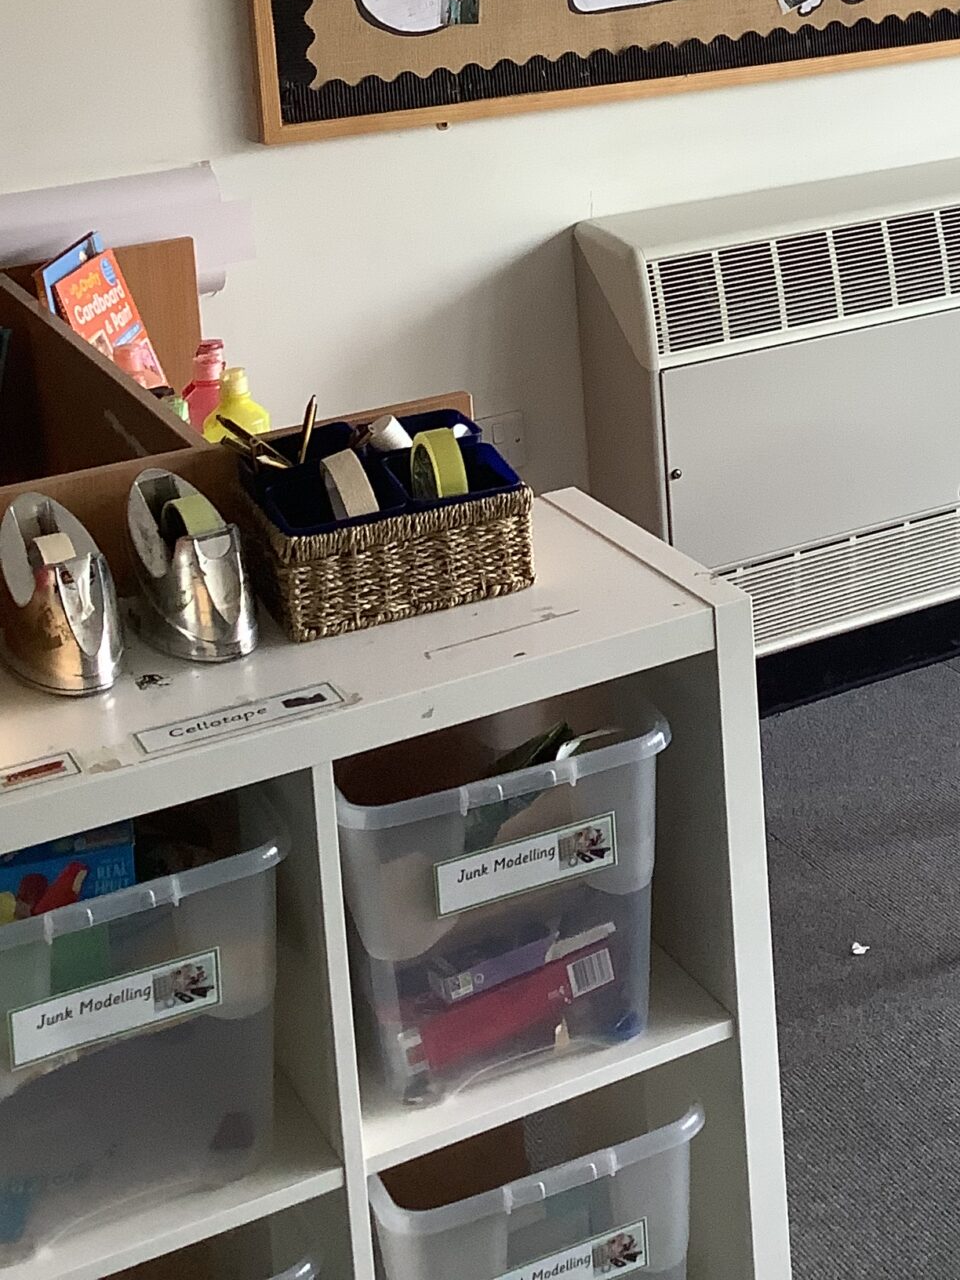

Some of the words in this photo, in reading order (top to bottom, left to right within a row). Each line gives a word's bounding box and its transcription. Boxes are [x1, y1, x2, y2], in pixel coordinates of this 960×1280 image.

[74, 279, 126, 325] Cardboard
[103, 319, 113, 334] &
[110, 302, 133, 331] Paint
[168, 706, 267, 738] Cellotape
[457, 863, 489, 883] Junk
[494, 846, 556, 873] Modelling
[36, 1006, 74, 1030] Junk
[79, 985, 152, 1015] Modelling
[531, 1254, 592, 1280] Modelling
